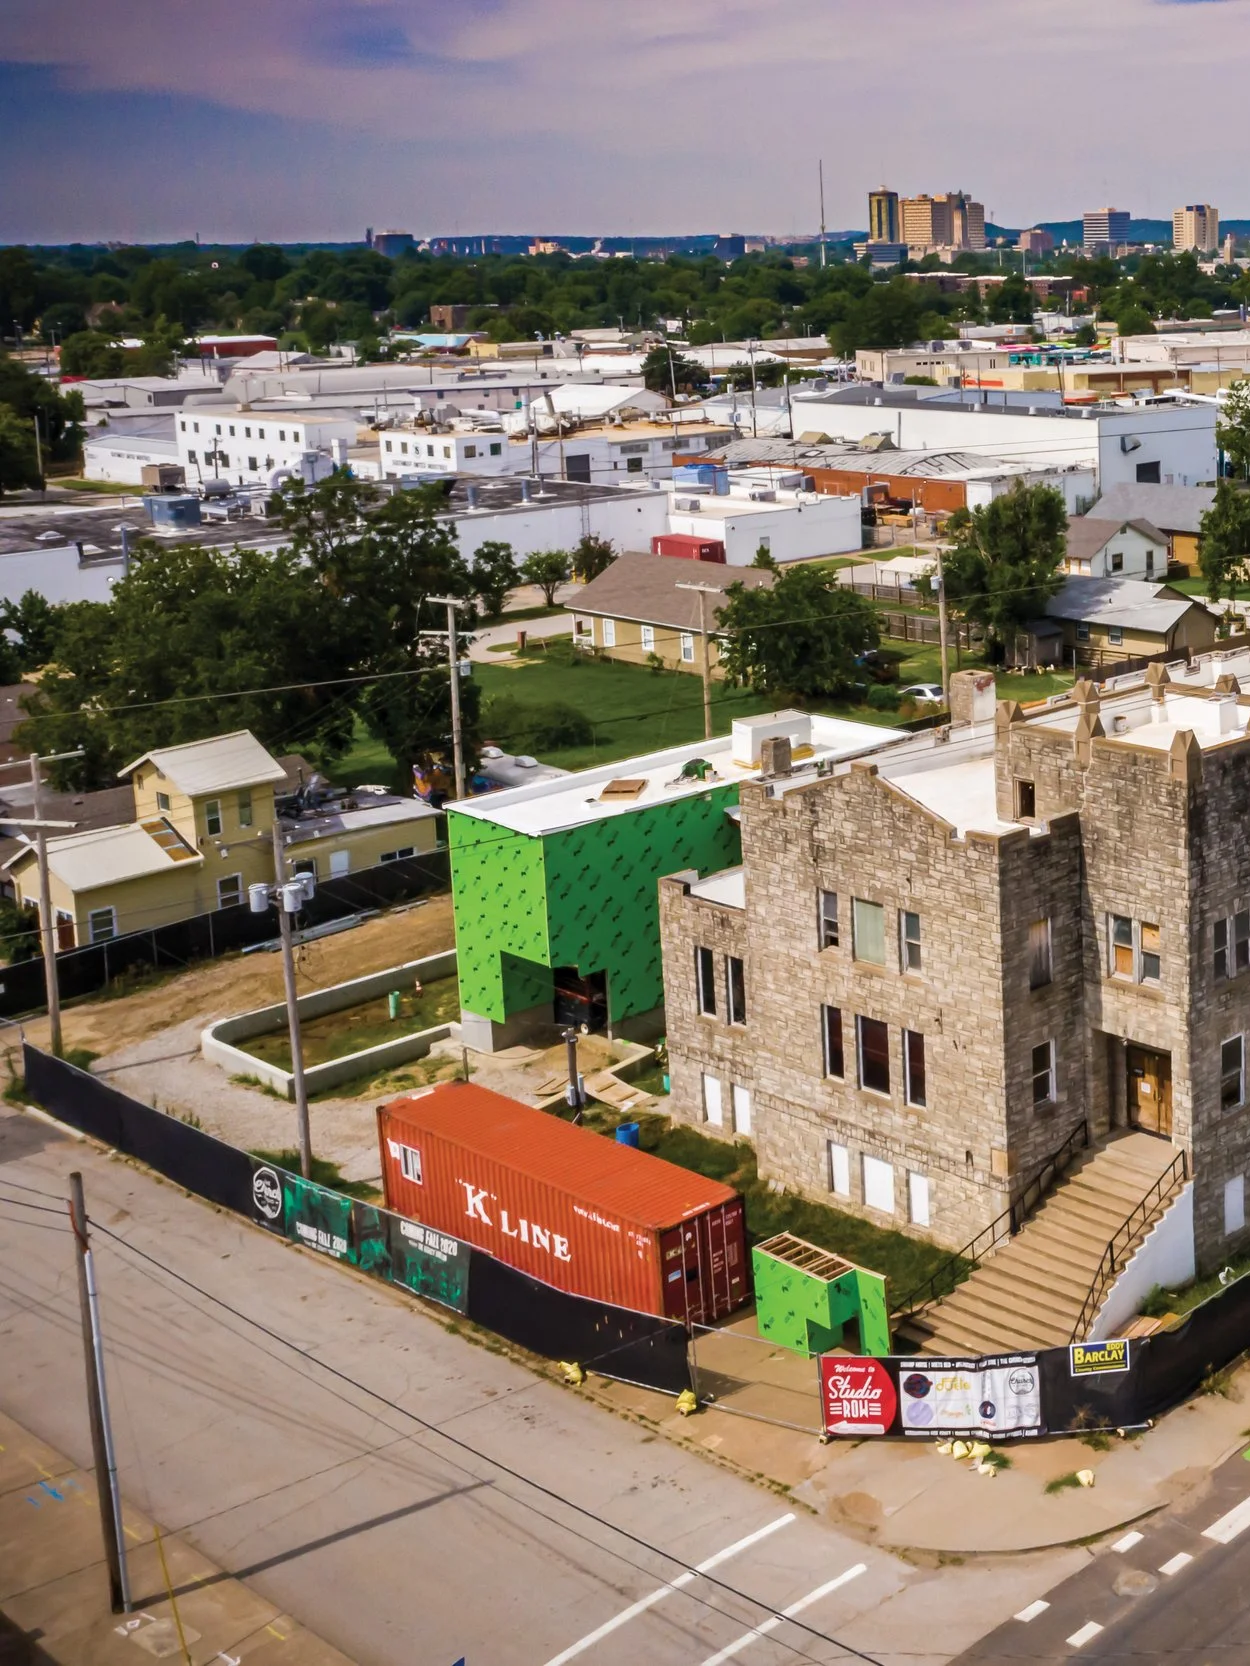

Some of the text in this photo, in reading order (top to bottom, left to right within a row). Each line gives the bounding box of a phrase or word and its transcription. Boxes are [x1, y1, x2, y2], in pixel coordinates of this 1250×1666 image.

[400, 1220, 425, 1243] COMING
[425, 1230, 440, 1250] FALL
[440, 1237, 458, 1257] 2020
[500, 1210, 572, 1263] LINE
[1073, 1347, 1125, 1365] BARCLAY
[1106, 1341, 1125, 1351] EDDY
[827, 1374, 883, 1400] Studio
[842, 1399, 869, 1419] ROW
